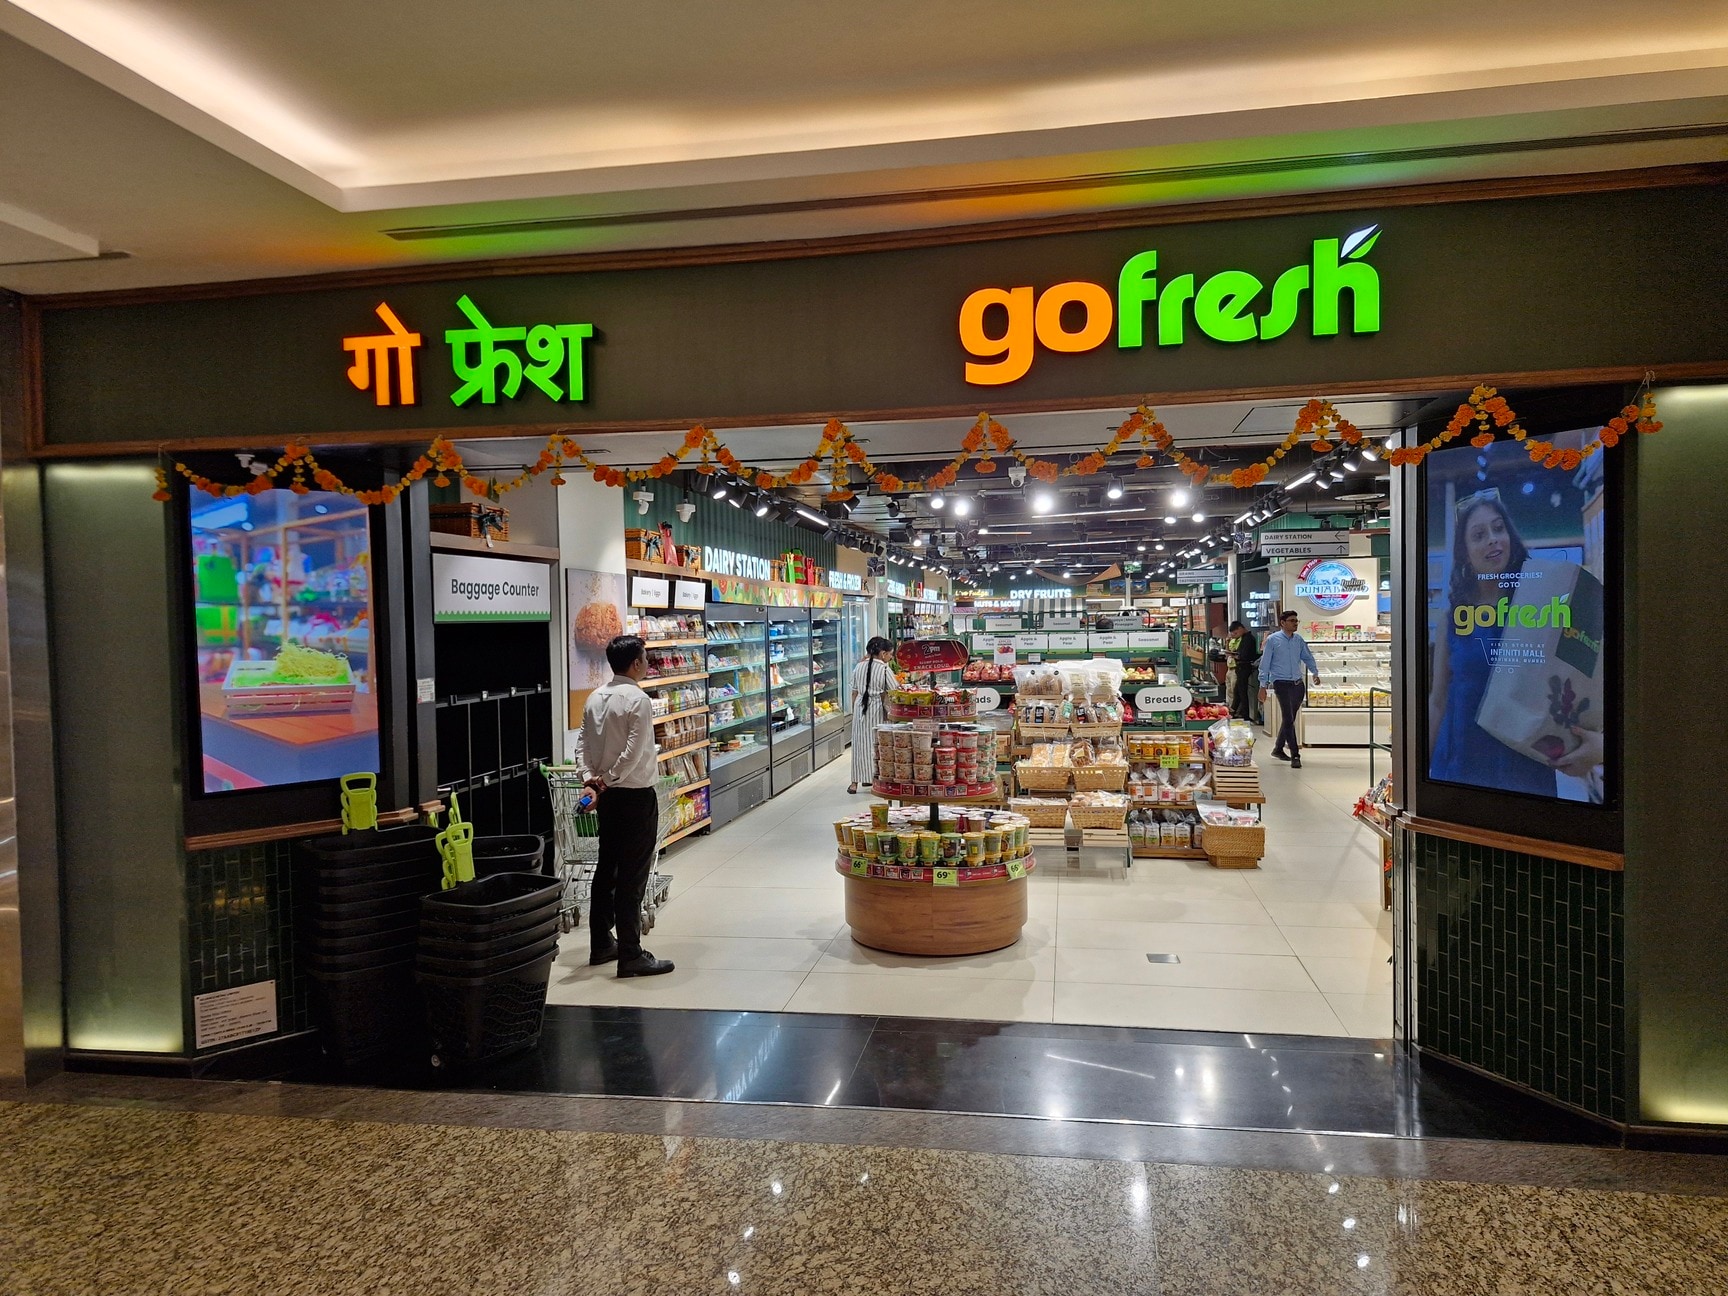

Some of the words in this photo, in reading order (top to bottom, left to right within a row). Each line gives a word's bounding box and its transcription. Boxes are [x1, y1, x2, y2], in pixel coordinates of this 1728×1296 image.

[959, 226, 1381, 386] gofresh
[343, 302, 422, 406] गो
[445, 294, 593, 407] फ्रेश
[1264, 533, 1284, 541] DAIRY
[1266, 546, 1312, 554] VEGETABLES
[704, 545, 736, 575] DAIRY
[735, 553, 771, 581] STATION
[451, 578, 501, 600] Baggage
[502, 581, 540, 597] Counter
[1010, 589, 1033, 599] DRY
[1034, 588, 1072, 599] FRUITS
[1453, 594, 1571, 636] gofresh
[1490, 648, 1520, 657] INFINITI
[1522, 649, 1545, 657] MALL
[1144, 695, 1183, 704] Breads
